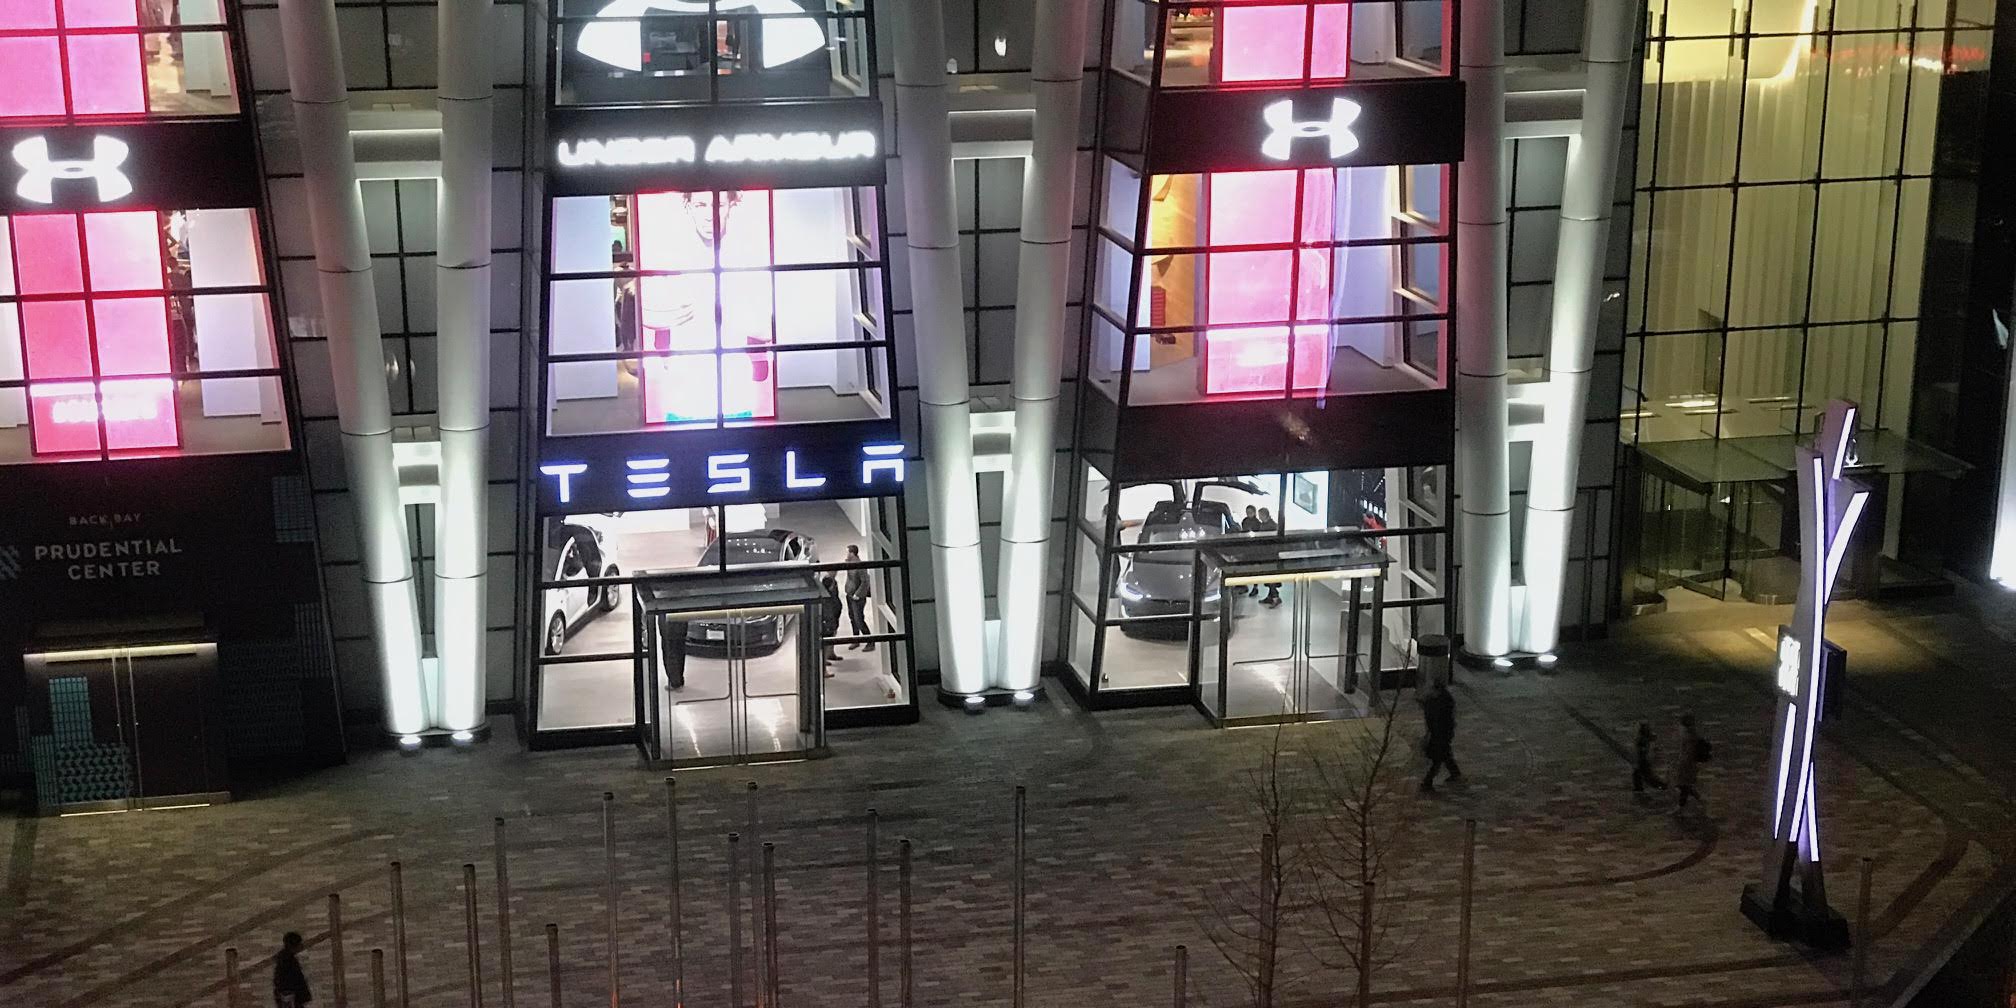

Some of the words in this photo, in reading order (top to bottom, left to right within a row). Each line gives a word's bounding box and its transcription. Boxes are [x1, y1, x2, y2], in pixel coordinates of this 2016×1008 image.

[540, 444, 905, 502] TESLA
[69, 515, 108, 526] BACK
[113, 512, 141, 523] BAY
[34, 538, 183, 560] PRUDENTIAL
[68, 561, 161, 580] CENTER
